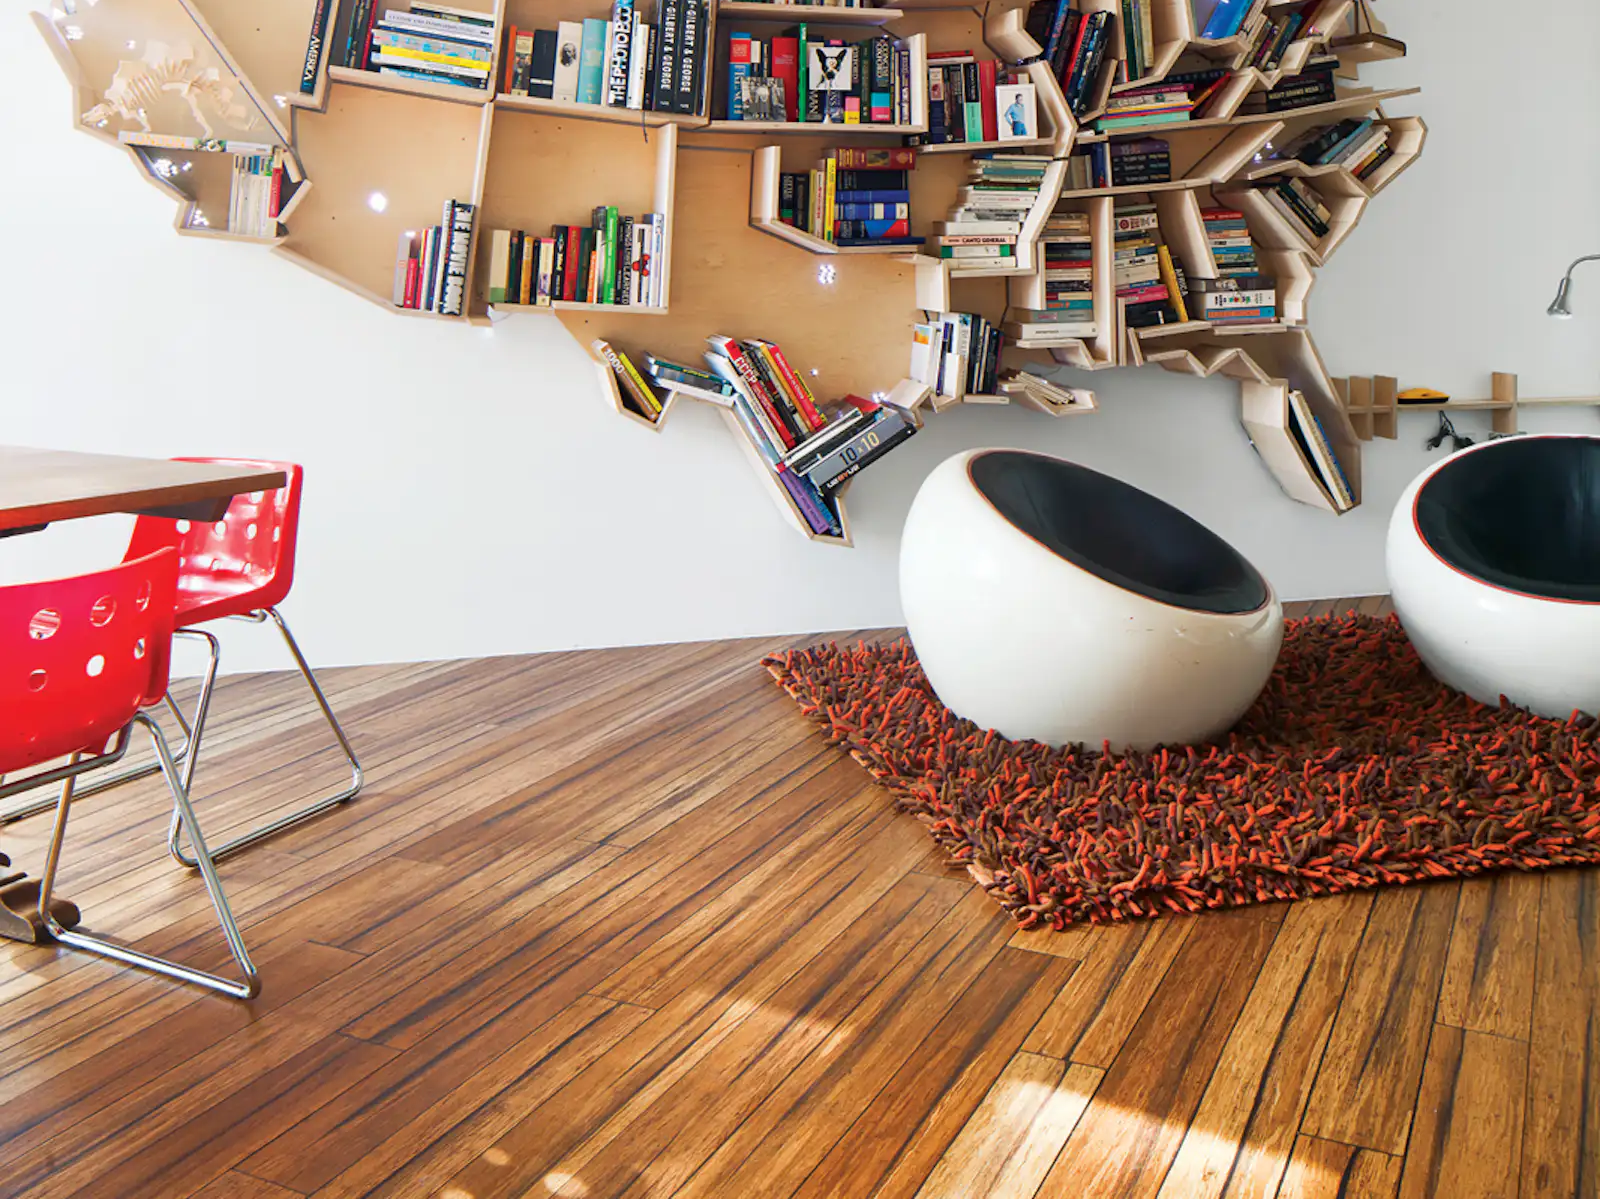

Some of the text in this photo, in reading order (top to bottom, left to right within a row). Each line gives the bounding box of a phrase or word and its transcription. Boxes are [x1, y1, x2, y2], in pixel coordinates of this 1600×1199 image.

[664, 6, 677, 44] GILBERT
[684, 9, 697, 47] GILBERT
[302, 34, 321, 81] AMERICA
[664, 45, 673, 53] &
[660, 54, 673, 89] GEORGE
[680, 57, 693, 92] GEORGE
[126, 131, 186, 148] LONDON
[619, 265, 632, 304] LEARNED
[1174, 267, 1189, 296] AFRICA
[604, 348, 624, 374] 1000
[734, 357, 757, 384] CCCP
[838, 447, 858, 466] 10
[860, 432, 880, 450] 10
